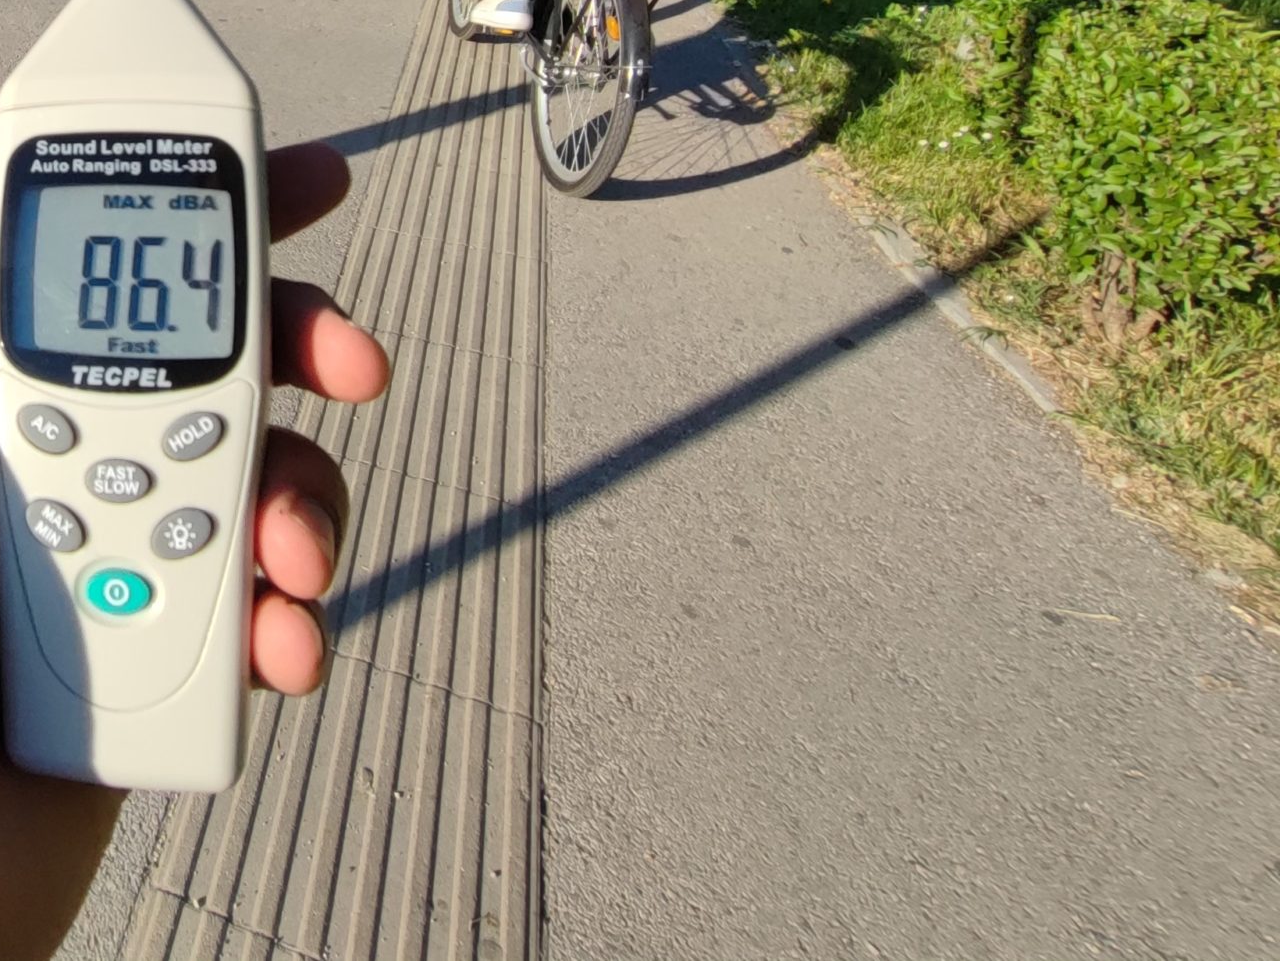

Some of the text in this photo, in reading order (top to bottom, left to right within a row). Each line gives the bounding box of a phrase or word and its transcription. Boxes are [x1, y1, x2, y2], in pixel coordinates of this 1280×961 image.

[35, 140, 213, 155] Sound Level Meter
[30, 159, 218, 176] Auto Ranging DSL-333
[103, 195, 218, 210] MAX dBA
[78, 236, 224, 332] 86.4
[107, 337, 160, 354] Fast
[71, 365, 173, 388] TECPEL
[30, 415, 61, 441] A/C
[168, 415, 215, 453] HOLD
[97, 465, 137, 480] FAST
[94, 480, 140, 495] SLOW
[41, 504, 74, 536] MAX
[34, 520, 62, 548] MIN
